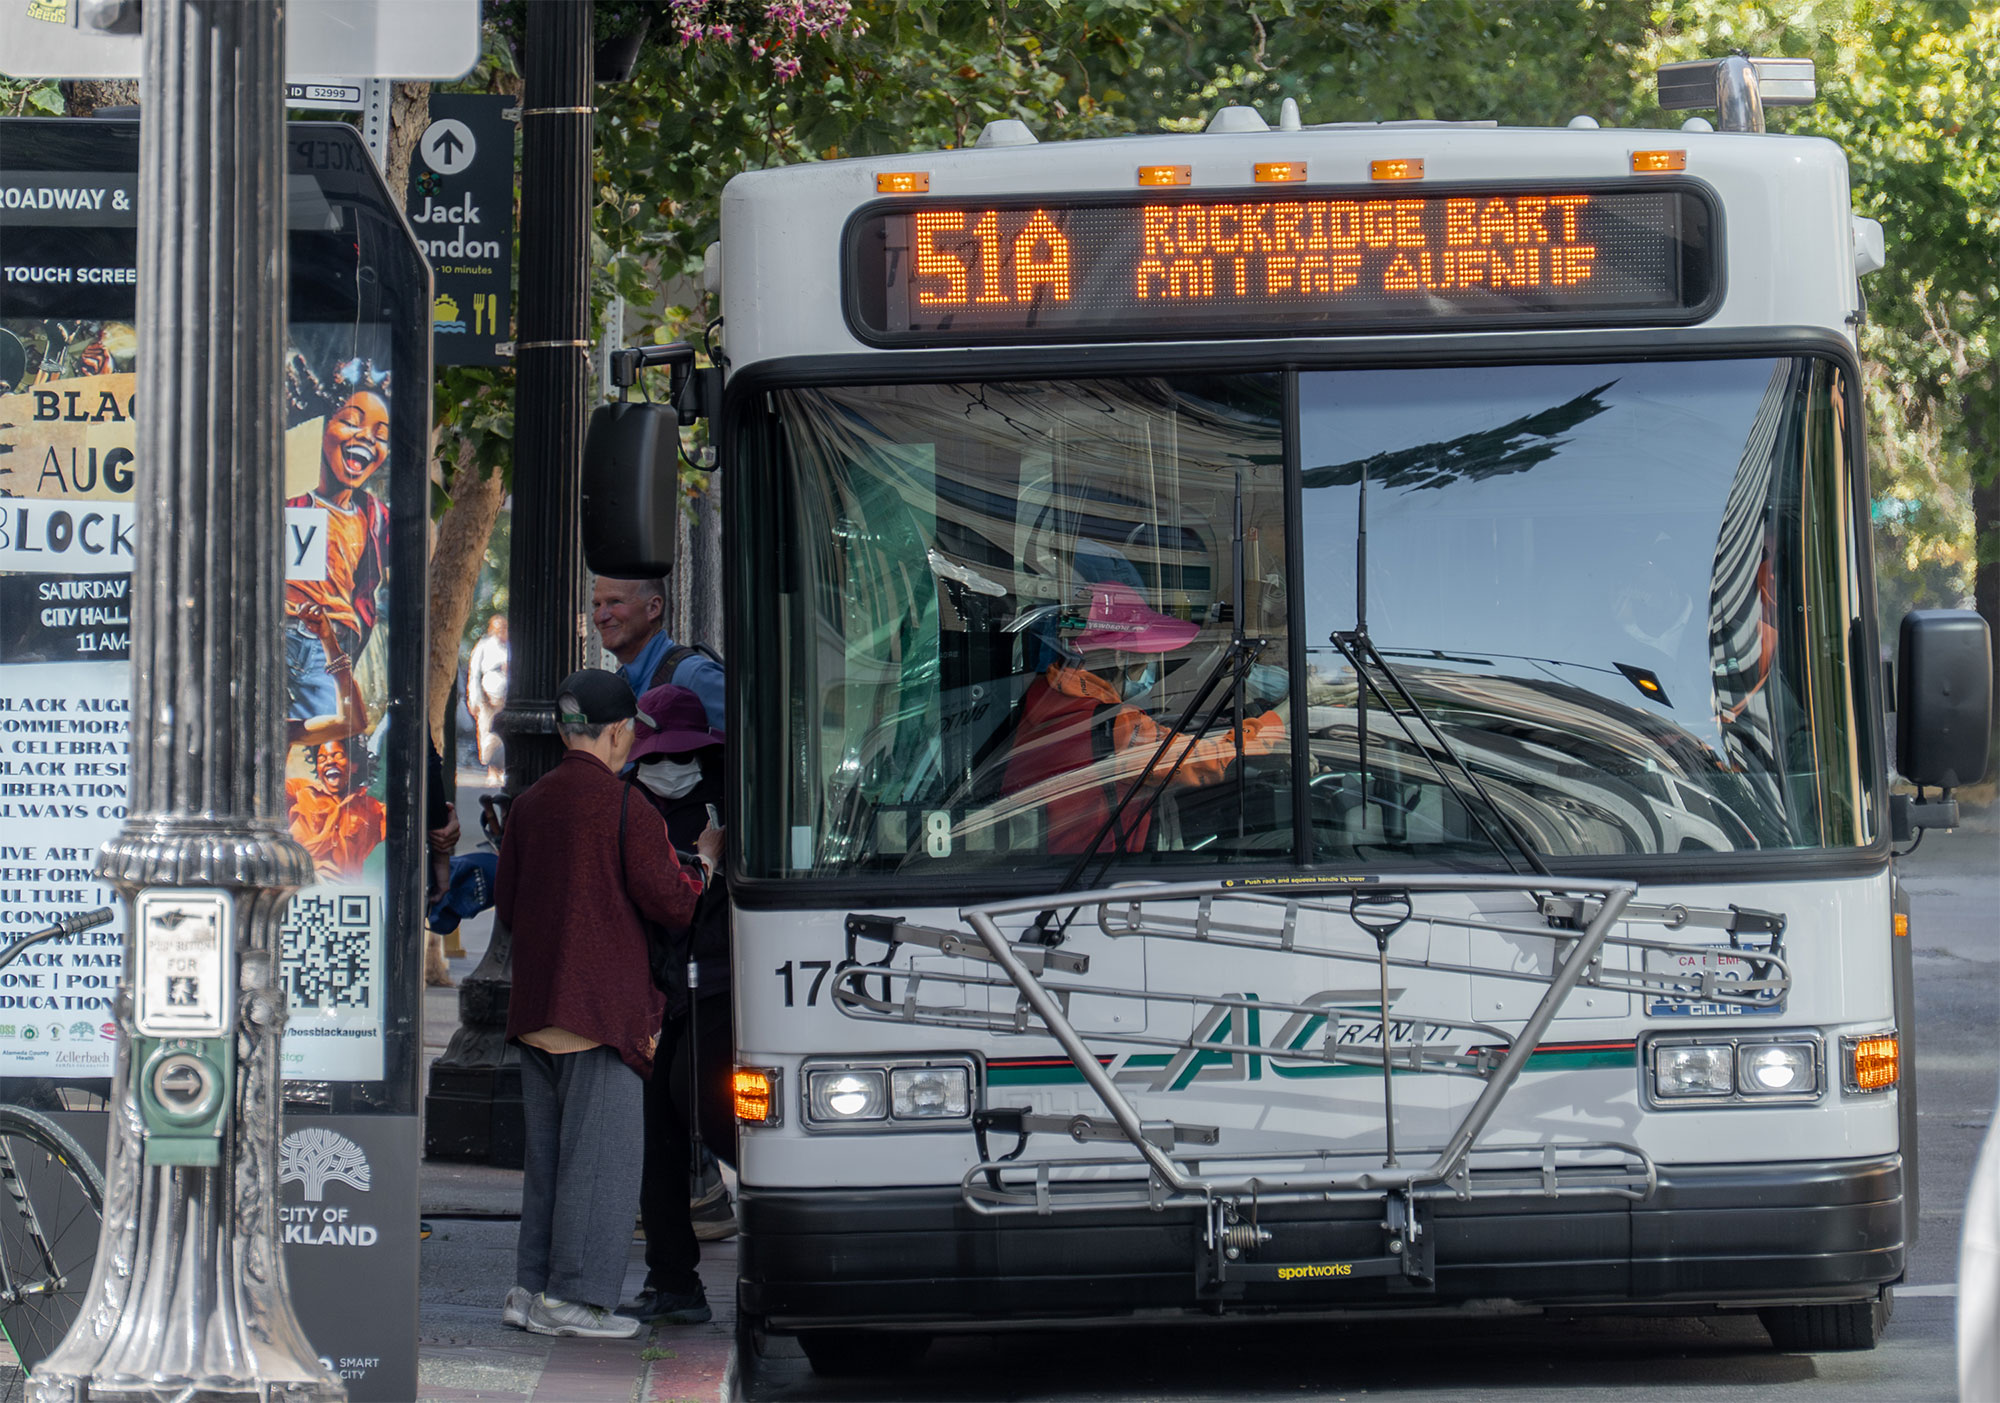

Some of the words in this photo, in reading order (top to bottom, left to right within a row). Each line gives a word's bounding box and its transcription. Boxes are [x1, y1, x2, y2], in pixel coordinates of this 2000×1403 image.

[291, 87, 303, 97] ID
[314, 87, 346, 98] 52999
[111, 189, 130, 211] &
[412, 191, 481, 224] Jack
[1143, 201, 1426, 255] ROCKRIDGE
[1446, 196, 1590, 246] BART
[916, 208, 1071, 304] 51A
[4, 267, 71, 283] TOUCH
[441, 265, 452, 274] 10
[454, 265, 493, 275] minutes
[37, 446, 136, 494] AUG
[39, 579, 128, 600] SATURDAY
[41, 607, 78, 628] CITY
[80, 606, 129, 625] HALL
[76, 632, 97, 652] 11
[0, 719, 131, 734] OMMEMORA
[0, 761, 66, 776] LACK
[74, 763, 130, 777] RESI
[0, 804, 89, 819] LWAYS
[927, 811, 952, 859] 8
[45, 847, 94, 862] ART
[0, 867, 97, 883] ERFORM
[1679, 955, 1696, 966] CA
[1690, 1004, 1742, 1016] GILLIG
[1147, 988, 1408, 1094] AC
[56, 1050, 110, 1063] Zellerbach
[279, 1207, 319, 1222] CITY
[322, 1208, 349, 1223] OF
[280, 1224, 378, 1247] KLAND
[1278, 1264, 1352, 1281] sportworks
[340, 1358, 379, 1368] SMART
[340, 1370, 366, 1380] CITY
